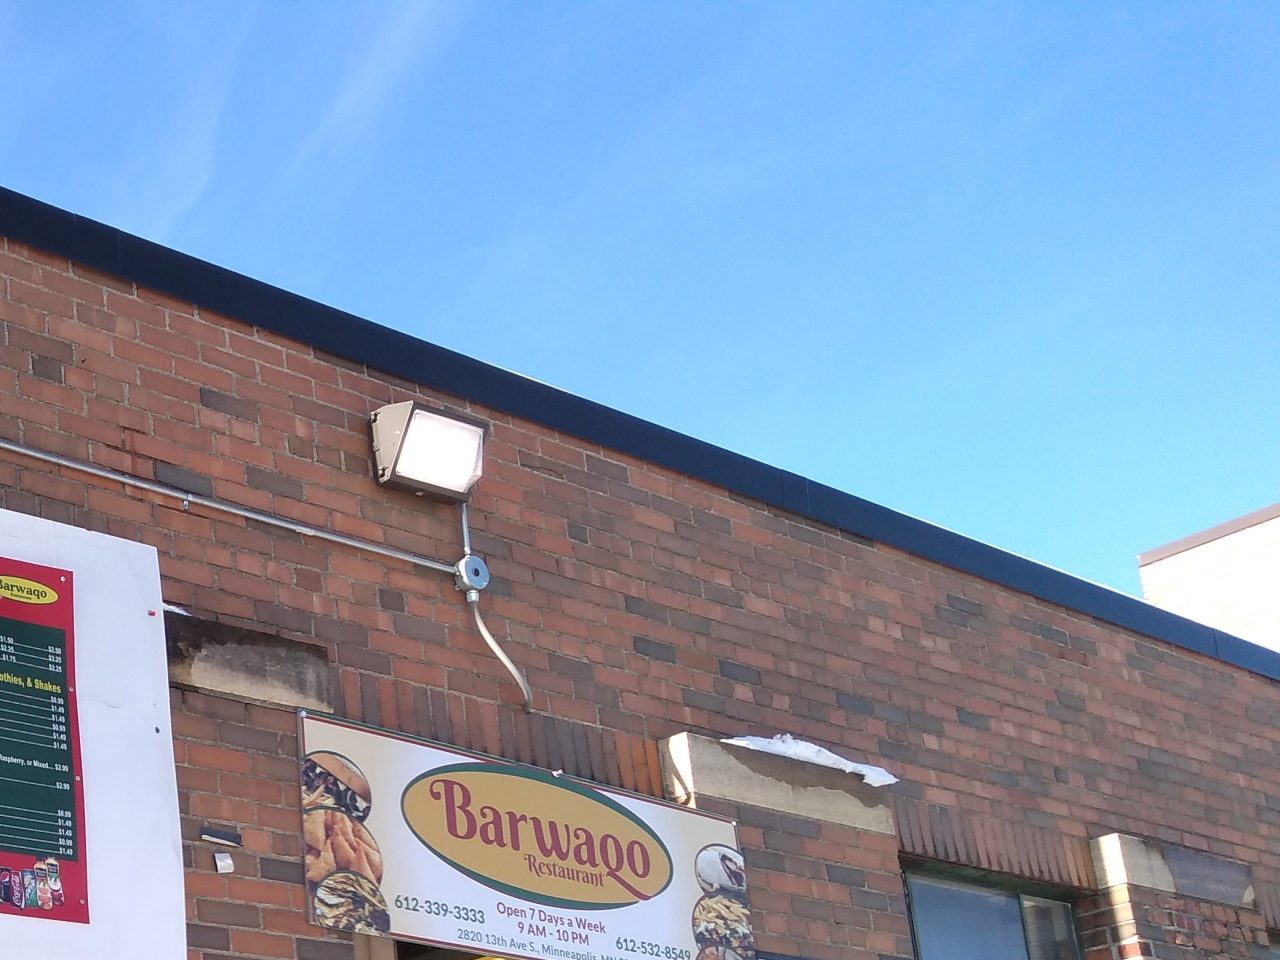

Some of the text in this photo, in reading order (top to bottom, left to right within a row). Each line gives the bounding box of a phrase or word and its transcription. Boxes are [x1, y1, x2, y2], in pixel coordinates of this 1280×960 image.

[26, 676, 32, 688] &
[34, 678, 61, 693] Shakes
[430, 779, 653, 900] Barwaqo
[524, 854, 606, 887] Restaurant
[395, 895, 485, 924] 612-339-3333
[497, 902, 606, 934] Open 7 Days a Week
[457, 928, 482, 942] 2820
[486, 933, 507, 947] 13th
[509, 938, 527, 951] Ave
[518, 922, 525, 934] 9
[528, 924, 547, 938] AM
[556, 929, 569, 942] 10
[572, 932, 589, 946] PM
